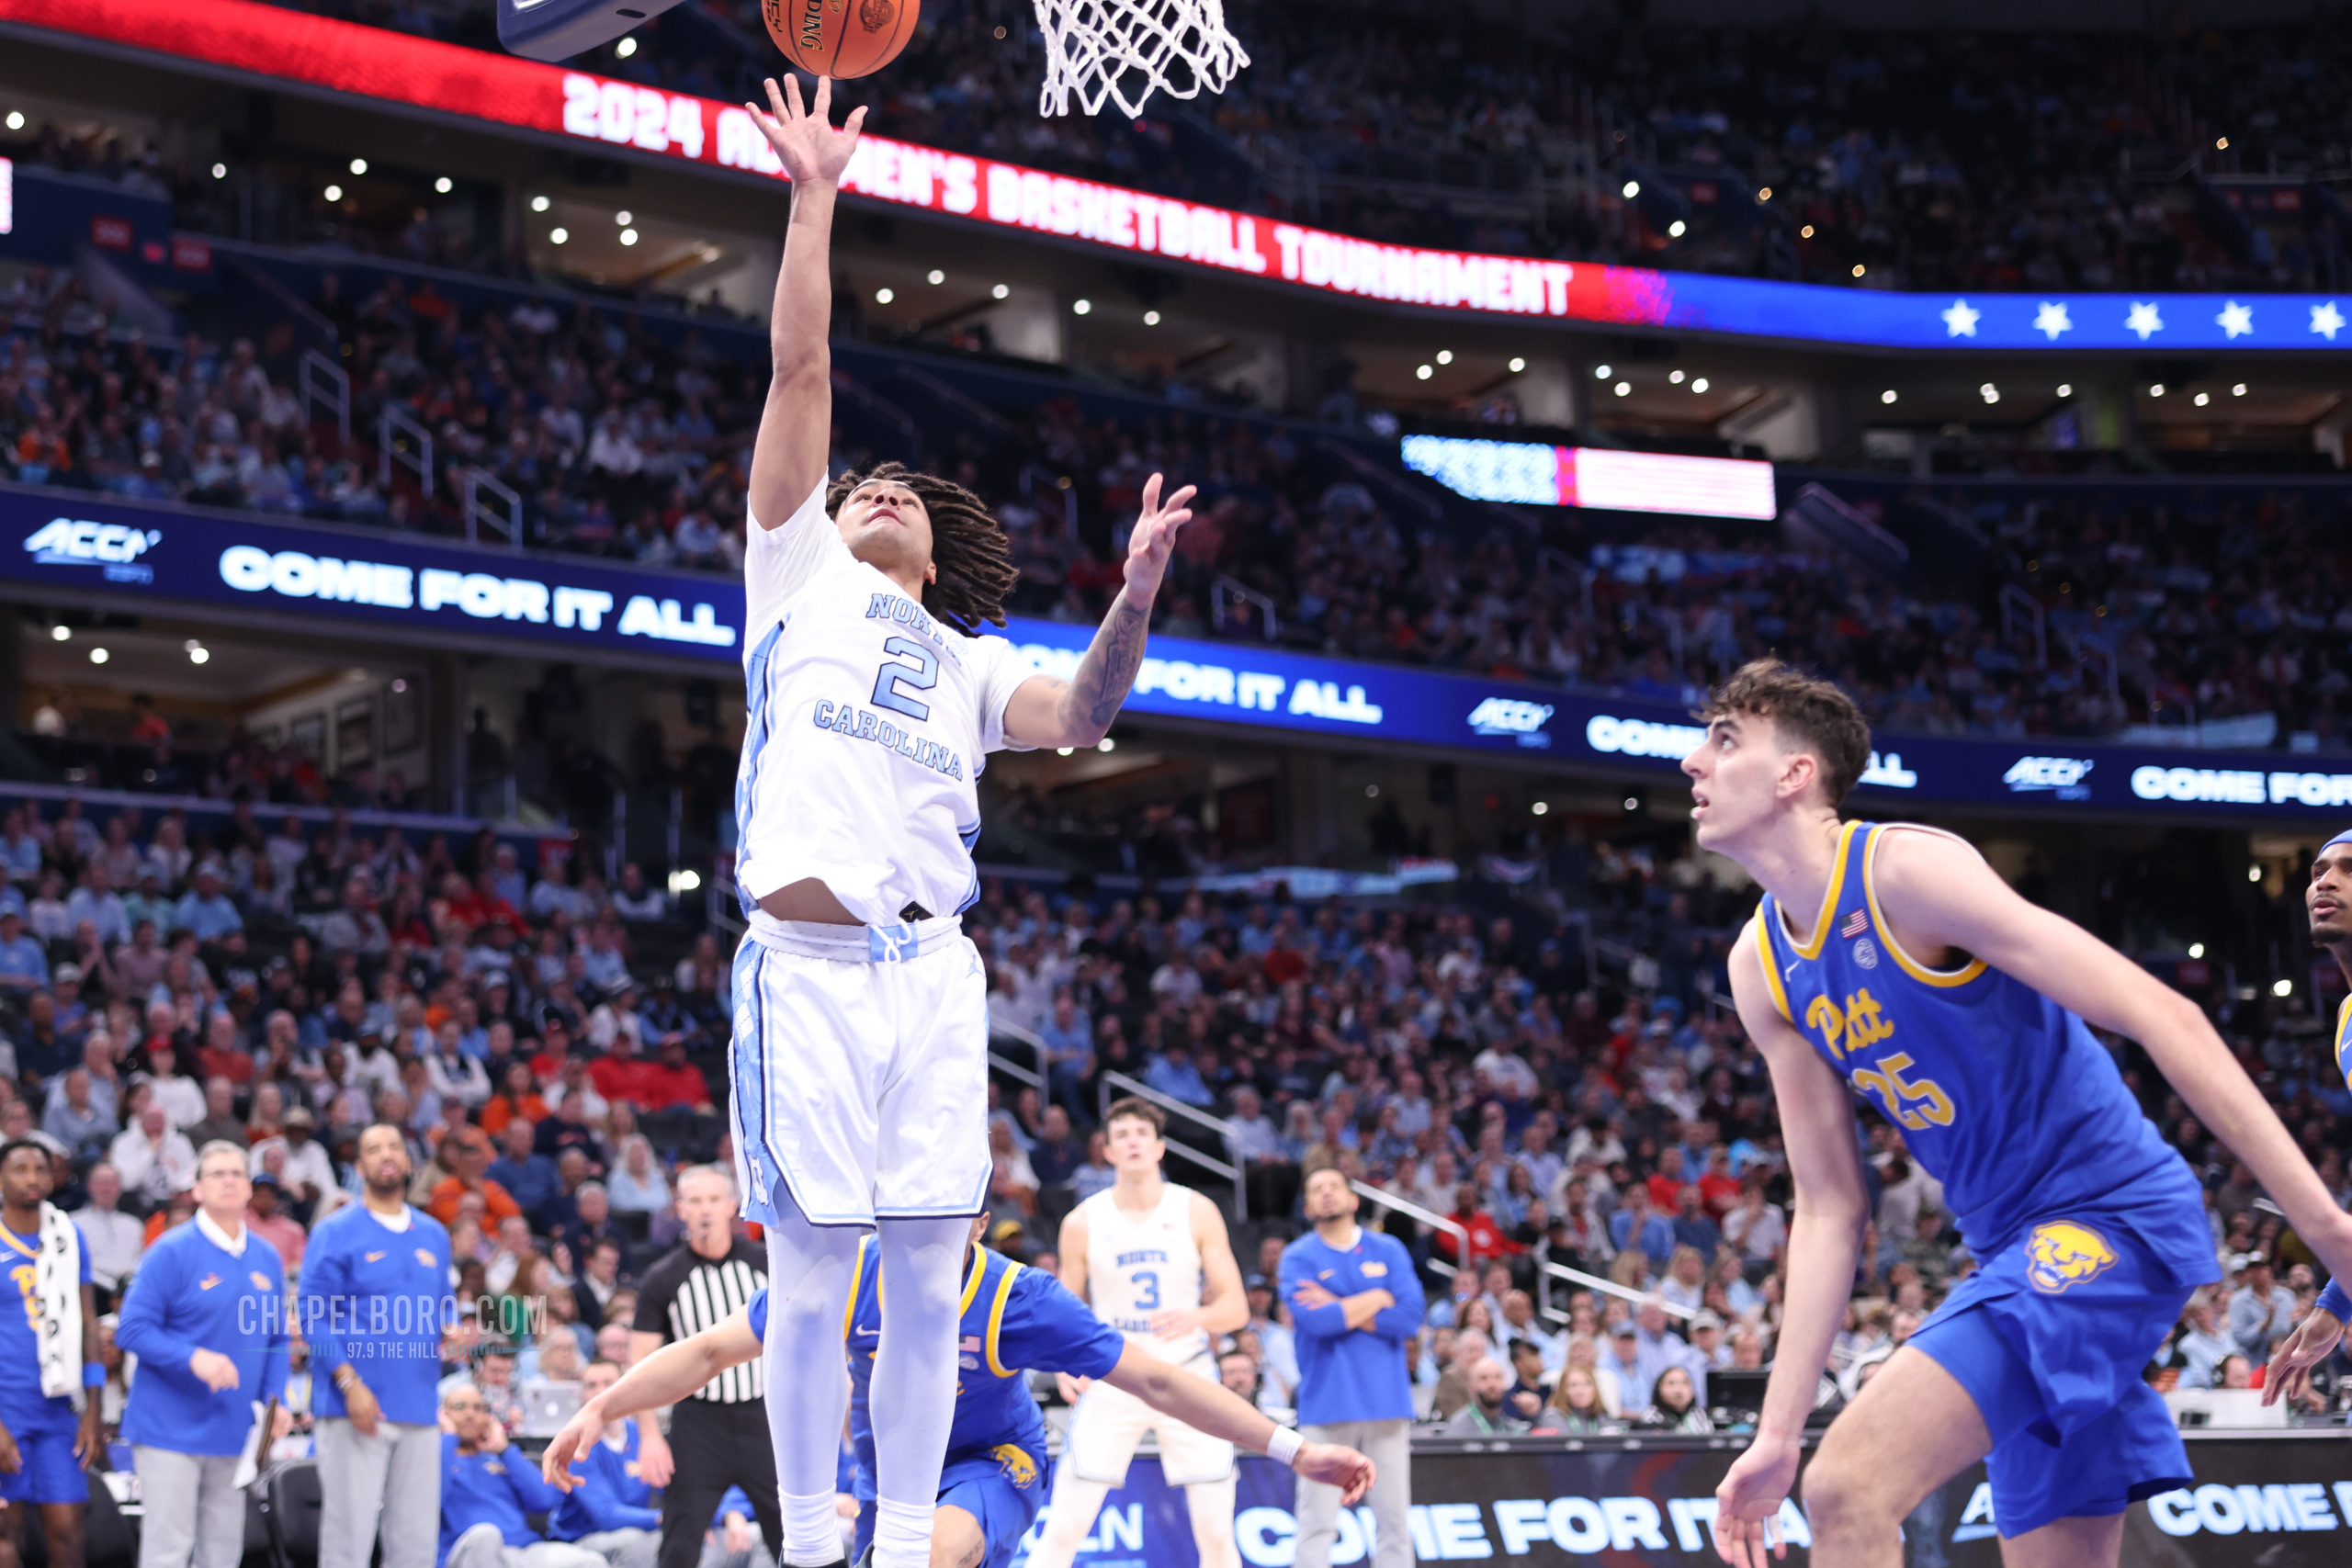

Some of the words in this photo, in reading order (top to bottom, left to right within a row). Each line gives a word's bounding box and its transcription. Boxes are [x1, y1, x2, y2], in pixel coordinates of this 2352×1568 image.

[562, 72, 705, 159] 2024
[987, 163, 1266, 274] BASKETBALL
[1274, 223, 1573, 315] TOURNAMENT
[219, 545, 413, 610] COME
[419, 568, 549, 624] FOR
[553, 586, 614, 631] IT
[616, 595, 736, 647] ALL
[870, 636, 940, 722] 2
[813, 699, 963, 782] CAROLINA
[1134, 657, 1236, 705] FOR
[1237, 671, 1285, 711] IT
[1288, 678, 1384, 725] ALL
[2131, 765, 2267, 804] COME
[1805, 987, 1894, 1060] Pitt
[1851, 1051, 1955, 1132] 25
[1131, 1271, 1159, 1309] 3
[1493, 1496, 1668, 1555] FOR
[2148, 1483, 2339, 1538] COME
